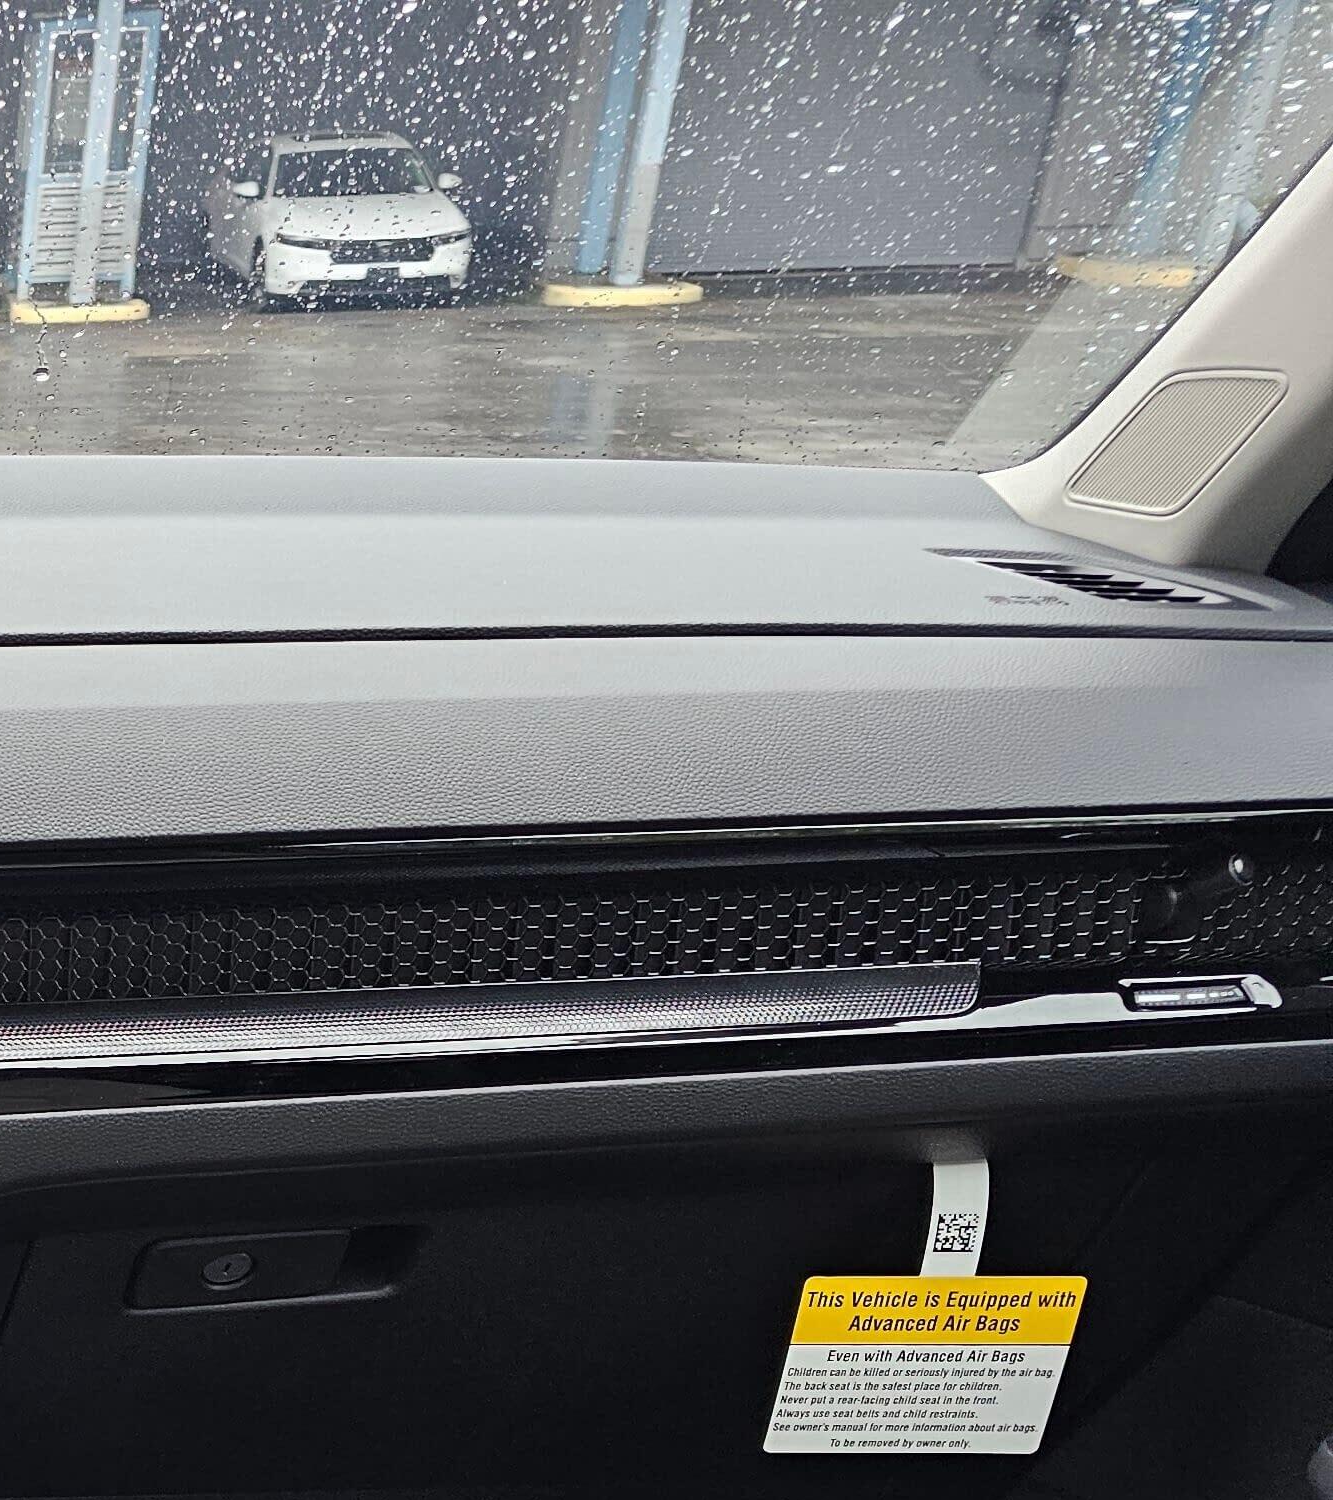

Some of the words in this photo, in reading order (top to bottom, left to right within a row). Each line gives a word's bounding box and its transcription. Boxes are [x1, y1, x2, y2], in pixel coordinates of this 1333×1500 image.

[807, 1291, 845, 1308] This
[852, 1291, 918, 1308] Vehicle
[924, 1291, 941, 1308] is
[946, 1291, 1033, 1310] Equipped
[1038, 1291, 1077, 1308] with
[848, 1315, 939, 1332] Advanced
[942, 1315, 971, 1332] Air
[975, 1315, 1021, 1335] Bags
[827, 1350, 860, 1363] Even
[864, 1350, 893, 1363] with
[896, 1350, 964, 1363] Advanced
[966, 1350, 987, 1363] Air
[991, 1350, 1026, 1365] Bags
[787, 1368, 828, 1377] Children
[829, 1369, 847, 1377] can
[849, 1368, 861, 1377] be
[863, 1368, 891, 1377] killed
[893, 1369, 903, 1377] or
[905, 1368, 949, 1378] seriously
[951, 1368, 986, 1378] injured
[987, 1368, 999, 1379] by
[1001, 1368, 1017, 1377] the
[1019, 1368, 1033, 1377] air
[1035, 1368, 1055, 1378] bag.
[785, 1382, 801, 1391] The
[804, 1382, 828, 1391] back
[829, 1382, 850, 1391] seat
[852, 1382, 861, 1391] is
[864, 1382, 879, 1391] the
[881, 1382, 912, 1391] safest
[914, 1382, 941, 1392] place
[943, 1382, 957, 1391] for
[959, 1382, 1002, 1391] children.
[780, 1396, 809, 1405] Never
[810, 1396, 826, 1405] put
[837, 1396, 891, 1406] rear-facing
[893, 1396, 917, 1405] child
[919, 1396, 941, 1405] seat
[943, 1396, 952, 1405] in
[955, 1396, 970, 1405] the
[973, 1396, 999, 1405] front.
[776, 1409, 811, 1419] Always
[813, 1410, 830, 1418] use
[832, 1409, 853, 1418] seat
[856, 1409, 879, 1418] belts
[882, 1409, 901, 1418] and
[903, 1409, 927, 1418] child
[929, 1409, 978, 1418] restraints.
[773, 1423, 791, 1432] See
[793, 1423, 830, 1432] owner's
[831, 1423, 868, 1432] manual
[869, 1423, 883, 1432] for
[884, 1424, 910, 1432] more
[911, 1423, 966, 1432] information
[968, 1423, 996, 1432] about
[997, 1423, 1011, 1432] air
[1013, 1423, 1038, 1433] bags.
[830, 1439, 841, 1447] To
[843, 1439, 855, 1447] be
[857, 1439, 900, 1447] removed
[901, 1439, 914, 1449] by
[916, 1439, 947, 1447] owner
[948, 1440, 971, 1449] only.
